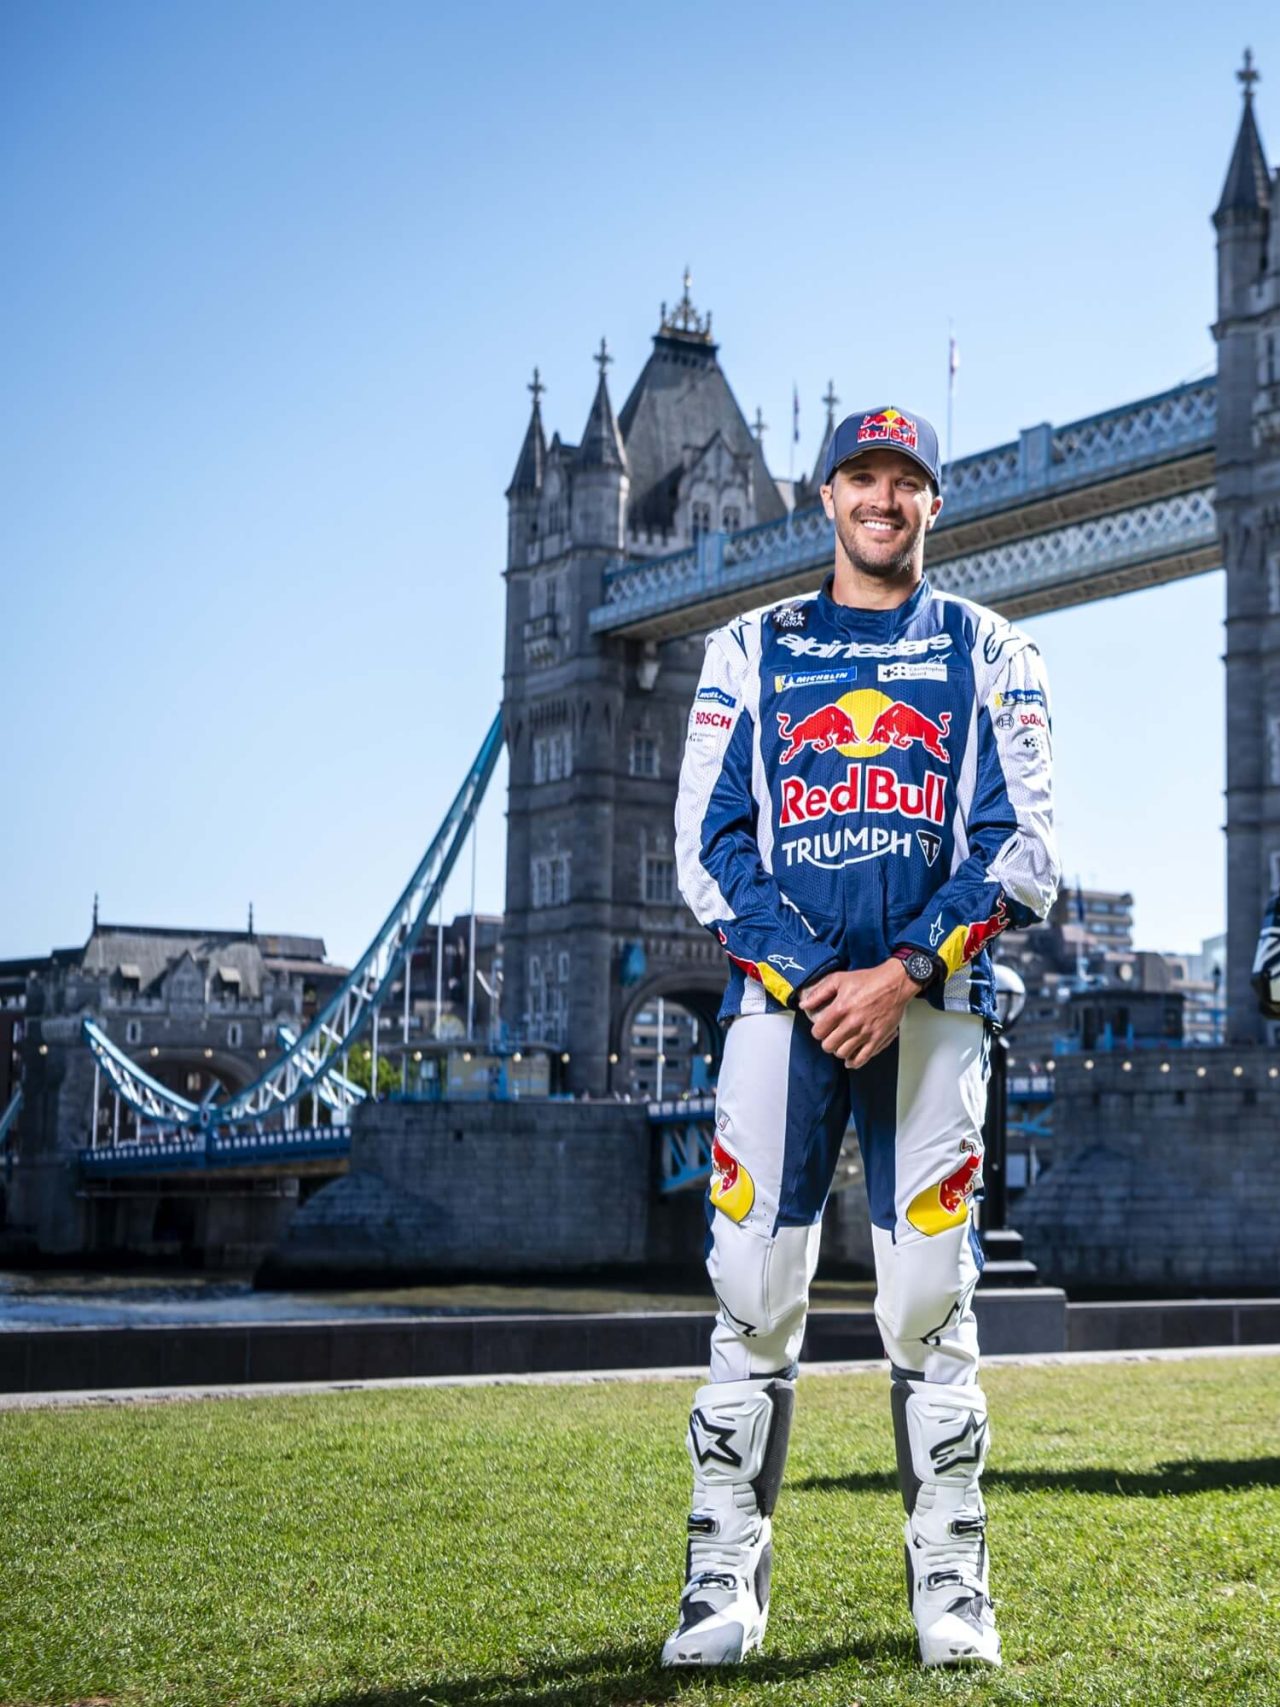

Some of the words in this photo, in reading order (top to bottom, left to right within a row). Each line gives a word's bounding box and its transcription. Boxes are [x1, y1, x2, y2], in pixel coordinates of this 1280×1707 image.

[857, 426, 888, 442] Red
[890, 427, 917, 449] Bull
[776, 633, 953, 658] alpinestars
[796, 671, 848, 684] MICHELIN
[695, 711, 732, 730] BOSCH
[780, 764, 860, 826] Red
[865, 766, 947, 825] Bull
[781, 827, 912, 870] TRIUMPH
